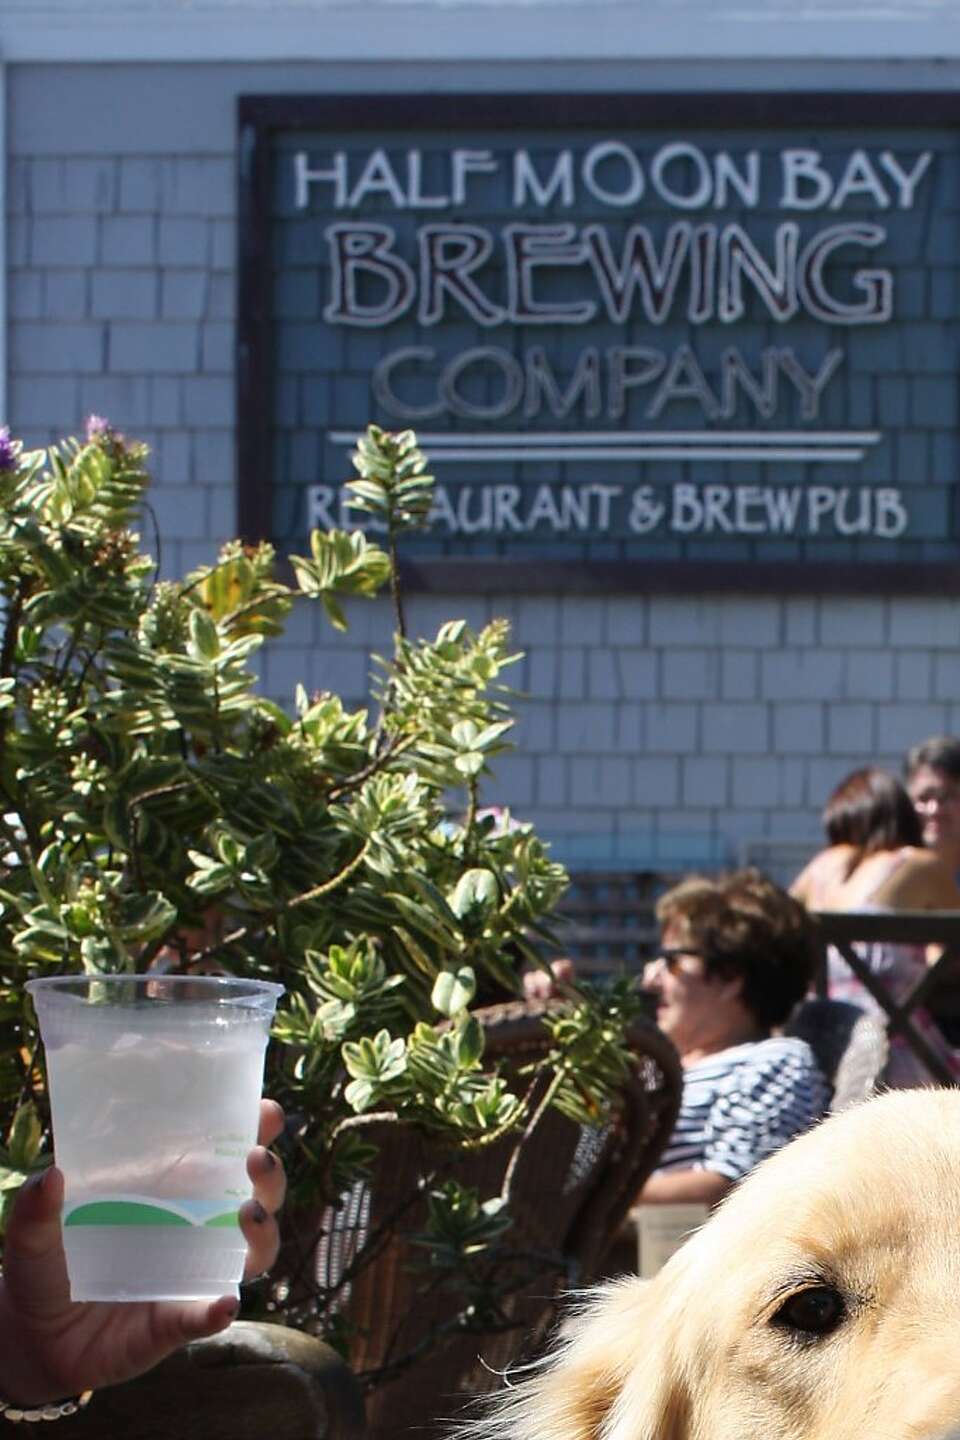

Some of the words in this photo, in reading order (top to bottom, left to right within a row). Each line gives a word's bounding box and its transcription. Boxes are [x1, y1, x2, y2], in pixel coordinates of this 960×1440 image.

[295, 150, 497, 207] HALF
[513, 142, 762, 208] MOON
[781, 149, 933, 208] BAY
[323, 221, 894, 326] BREWING
[372, 346, 843, 419] COMPANY
[307, 484, 620, 532] REAURANT
[629, 484, 665, 534] &
